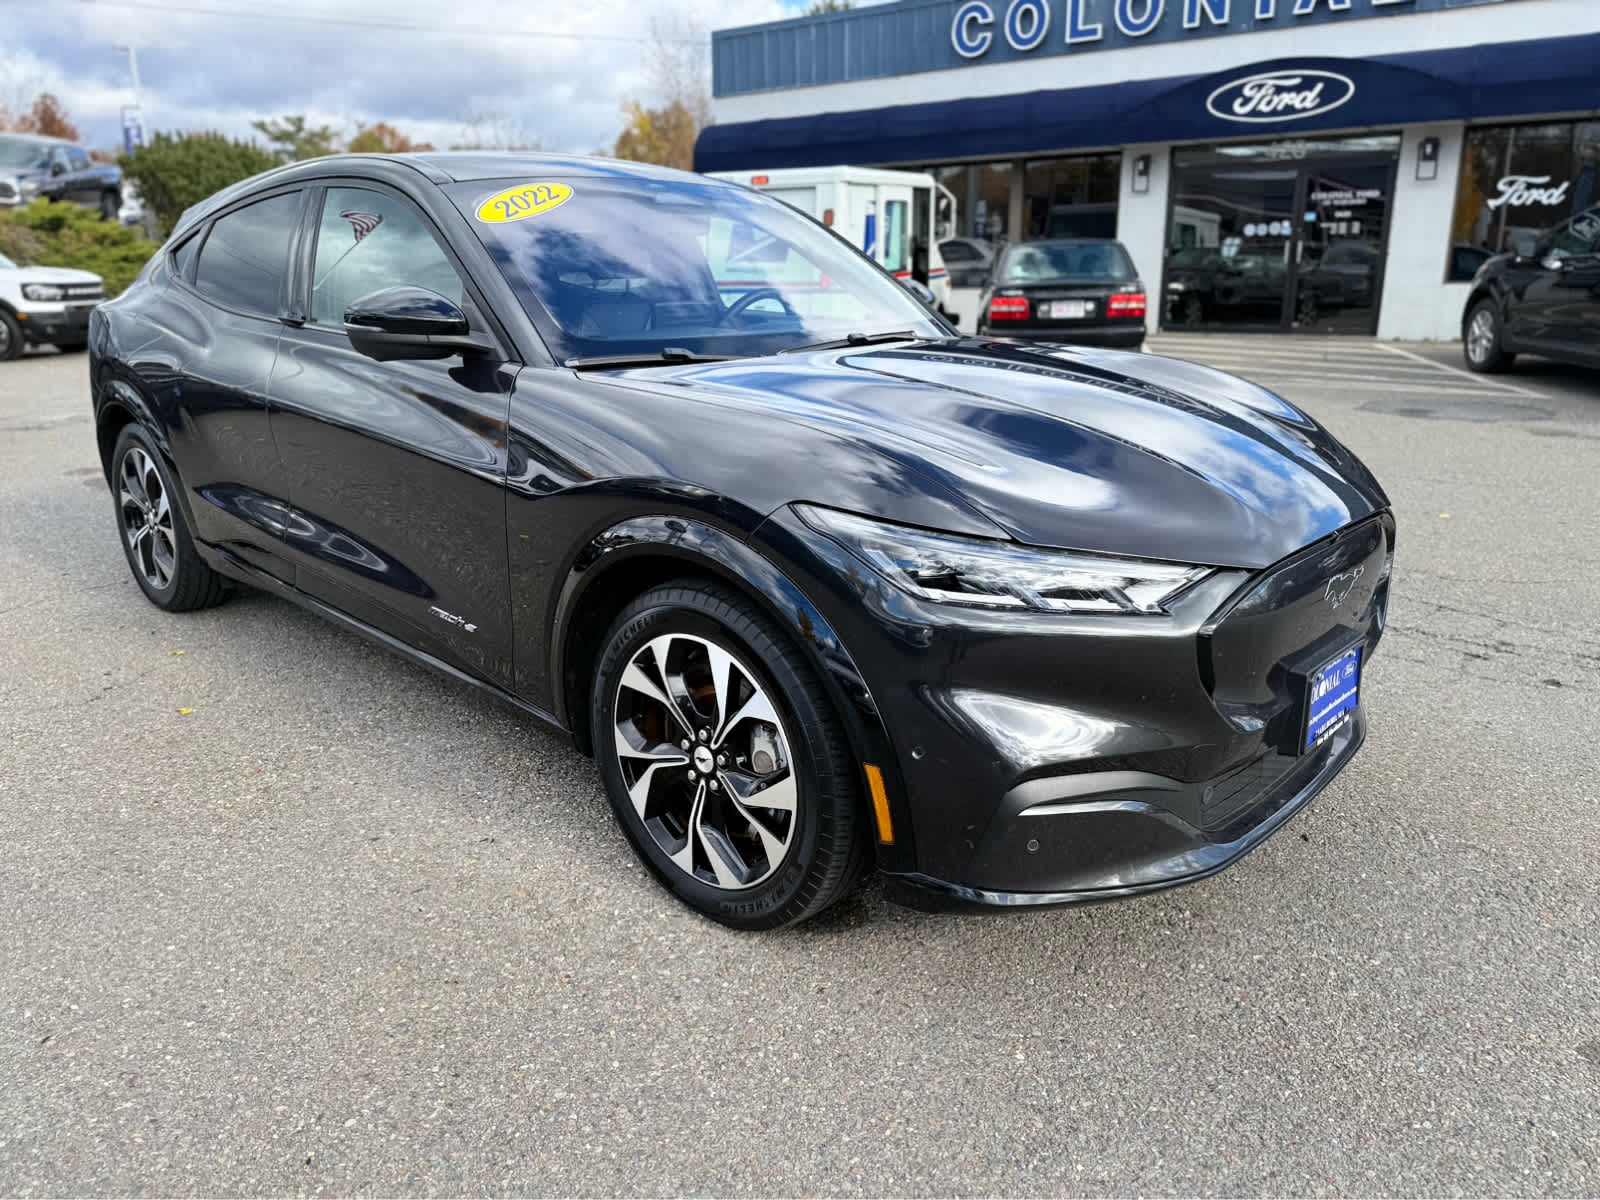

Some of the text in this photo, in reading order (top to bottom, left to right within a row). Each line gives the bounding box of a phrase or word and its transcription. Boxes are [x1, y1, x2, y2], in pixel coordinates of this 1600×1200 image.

[951, 0, 1412, 58] COLON
[1232, 77, 1325, 115] Ford
[494, 185, 560, 218] 2022
[1487, 175, 1570, 210] Ford
